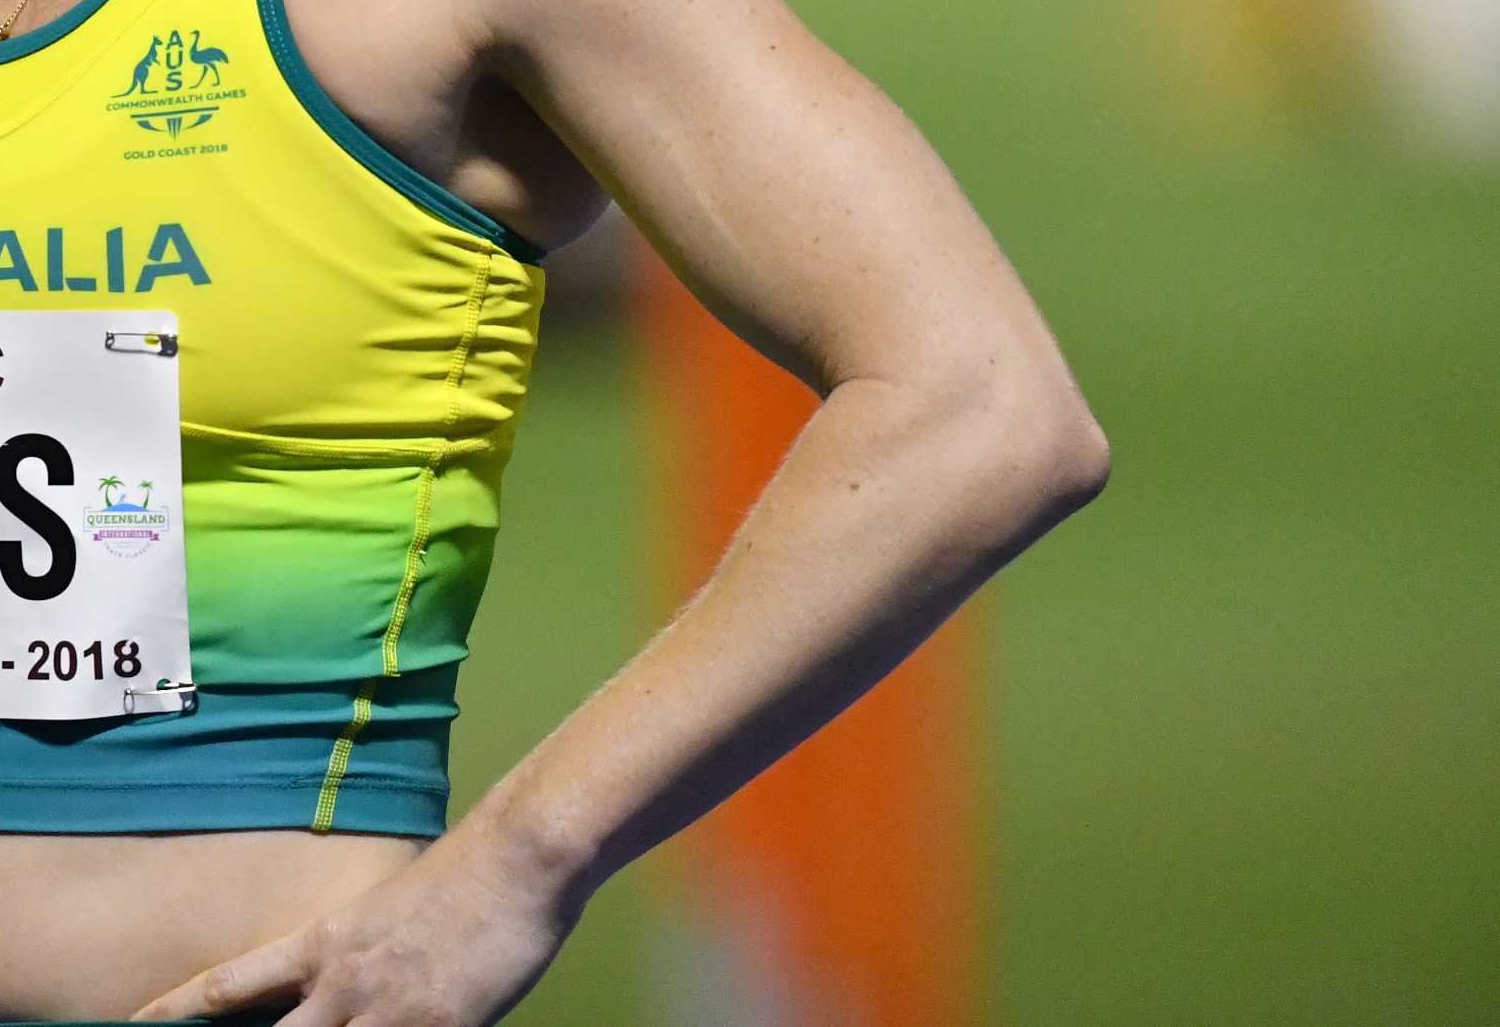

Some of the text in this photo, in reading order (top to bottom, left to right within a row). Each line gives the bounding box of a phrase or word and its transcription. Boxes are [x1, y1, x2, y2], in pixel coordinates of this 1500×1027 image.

[166, 30, 184, 91] AUS
[106, 89, 246, 112] COMMONWEALTH GAMES
[123, 143, 229, 160] GOLD COAST 2018
[87, 514, 166, 526] QUEENSLAND
[1, 660, 15, 669] -
[27, 639, 142, 680] 2018
